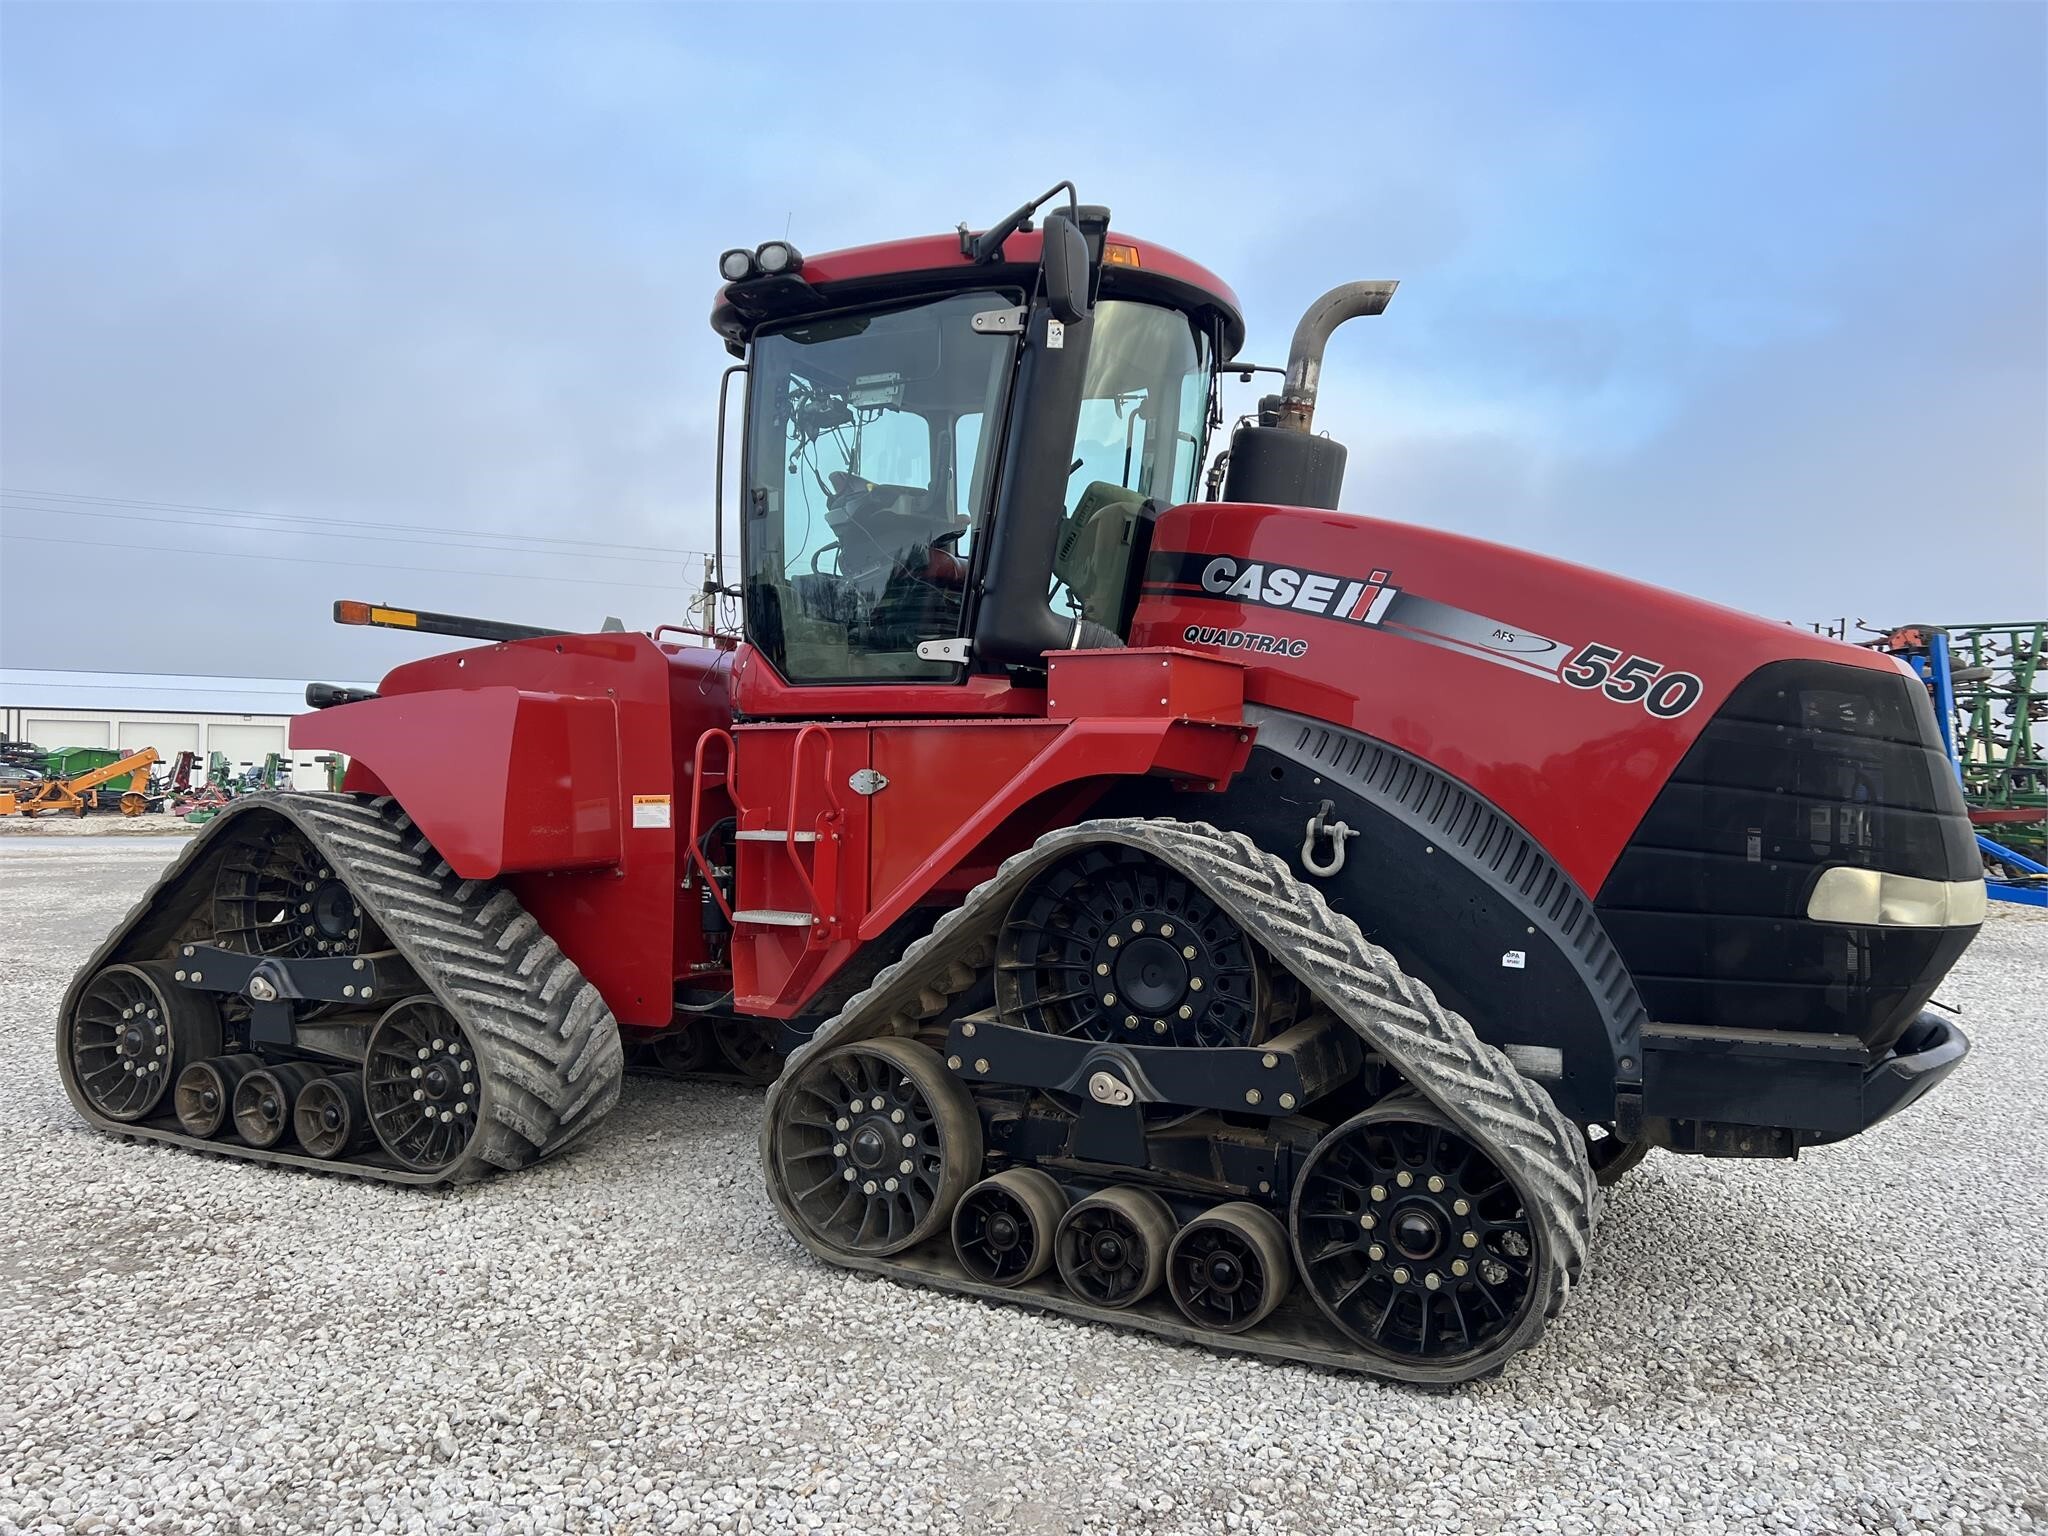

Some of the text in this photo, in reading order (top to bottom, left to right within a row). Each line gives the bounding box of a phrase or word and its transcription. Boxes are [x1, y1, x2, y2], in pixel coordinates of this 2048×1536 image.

[1201, 557, 1340, 614] CASE
[1183, 624, 1308, 658] QUADTRAC
[1492, 629, 1516, 643] AFS
[1561, 641, 1704, 720] 550
